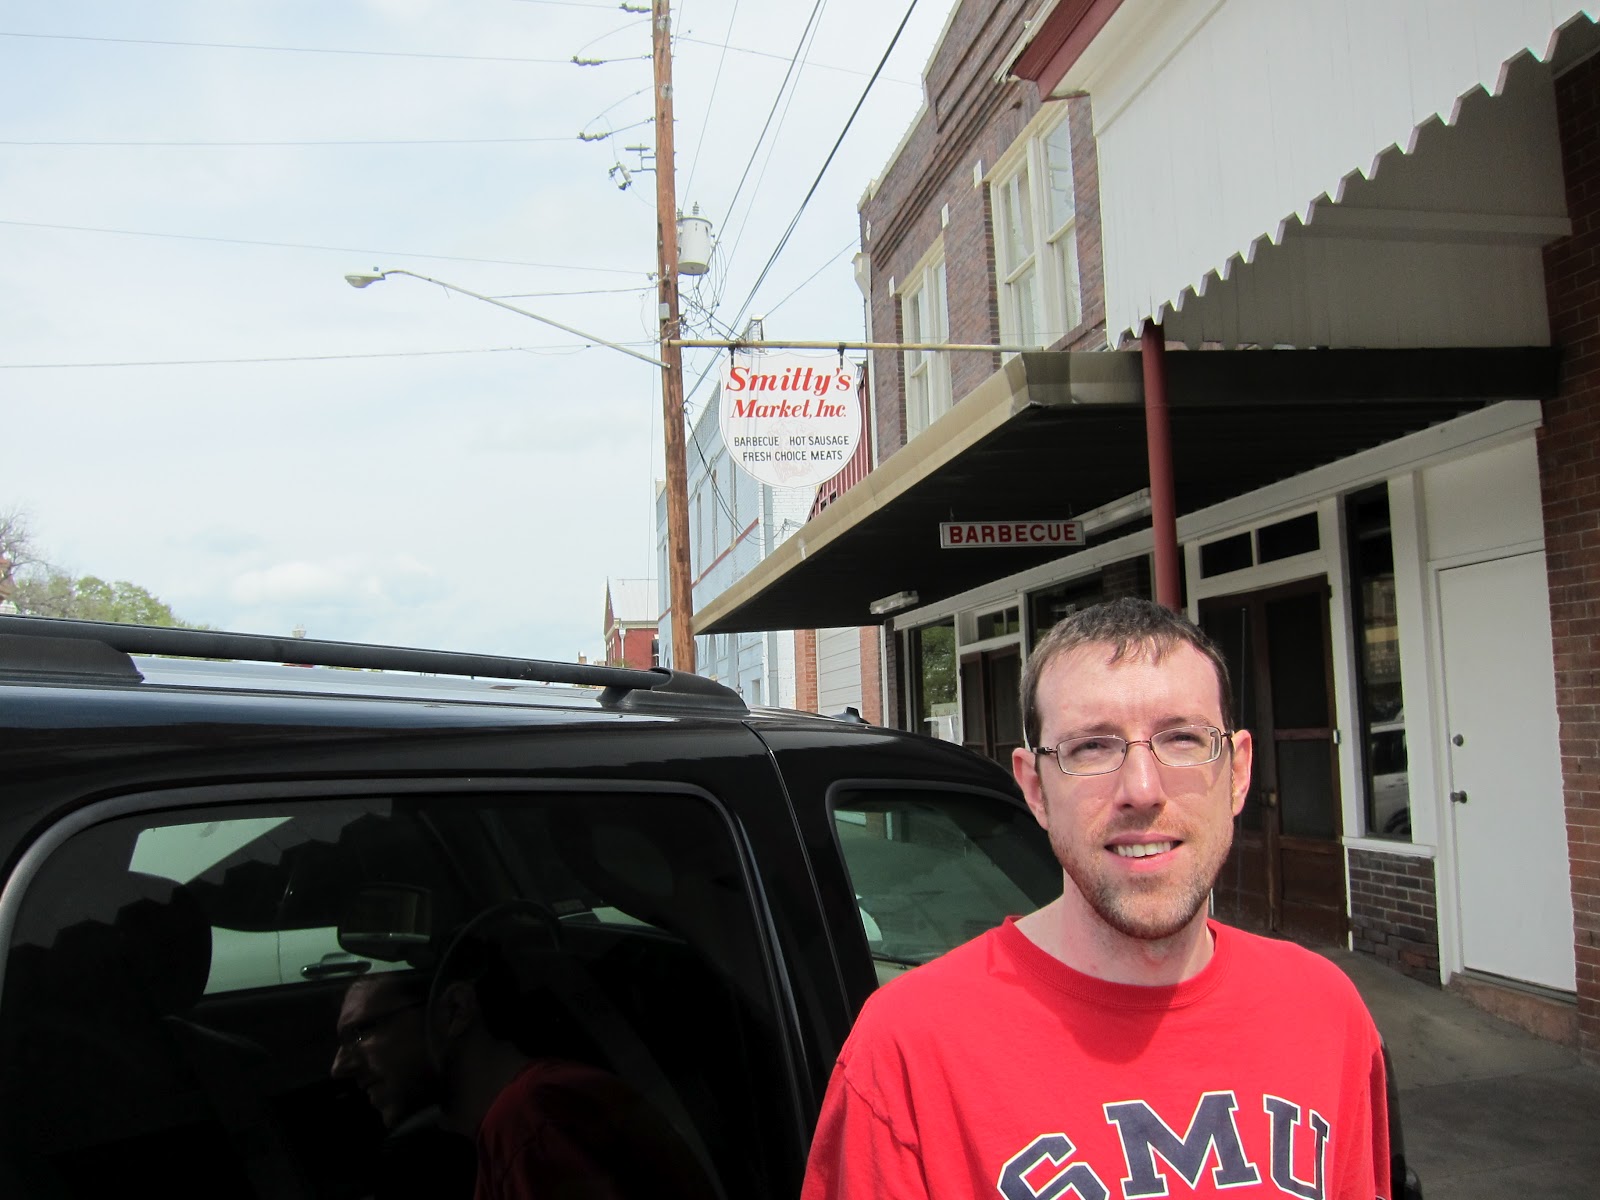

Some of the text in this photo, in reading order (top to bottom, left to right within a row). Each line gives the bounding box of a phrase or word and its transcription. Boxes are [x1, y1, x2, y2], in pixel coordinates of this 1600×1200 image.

[725, 366, 851, 396] Smitty's
[734, 435, 850, 447] BARBECUE HOT SAUSAGE
[742, 450, 843, 462] FRESH CHOICE MEATS
[949, 523, 1077, 544] BARBECUE
[997, 1090, 1331, 1200] SMU
